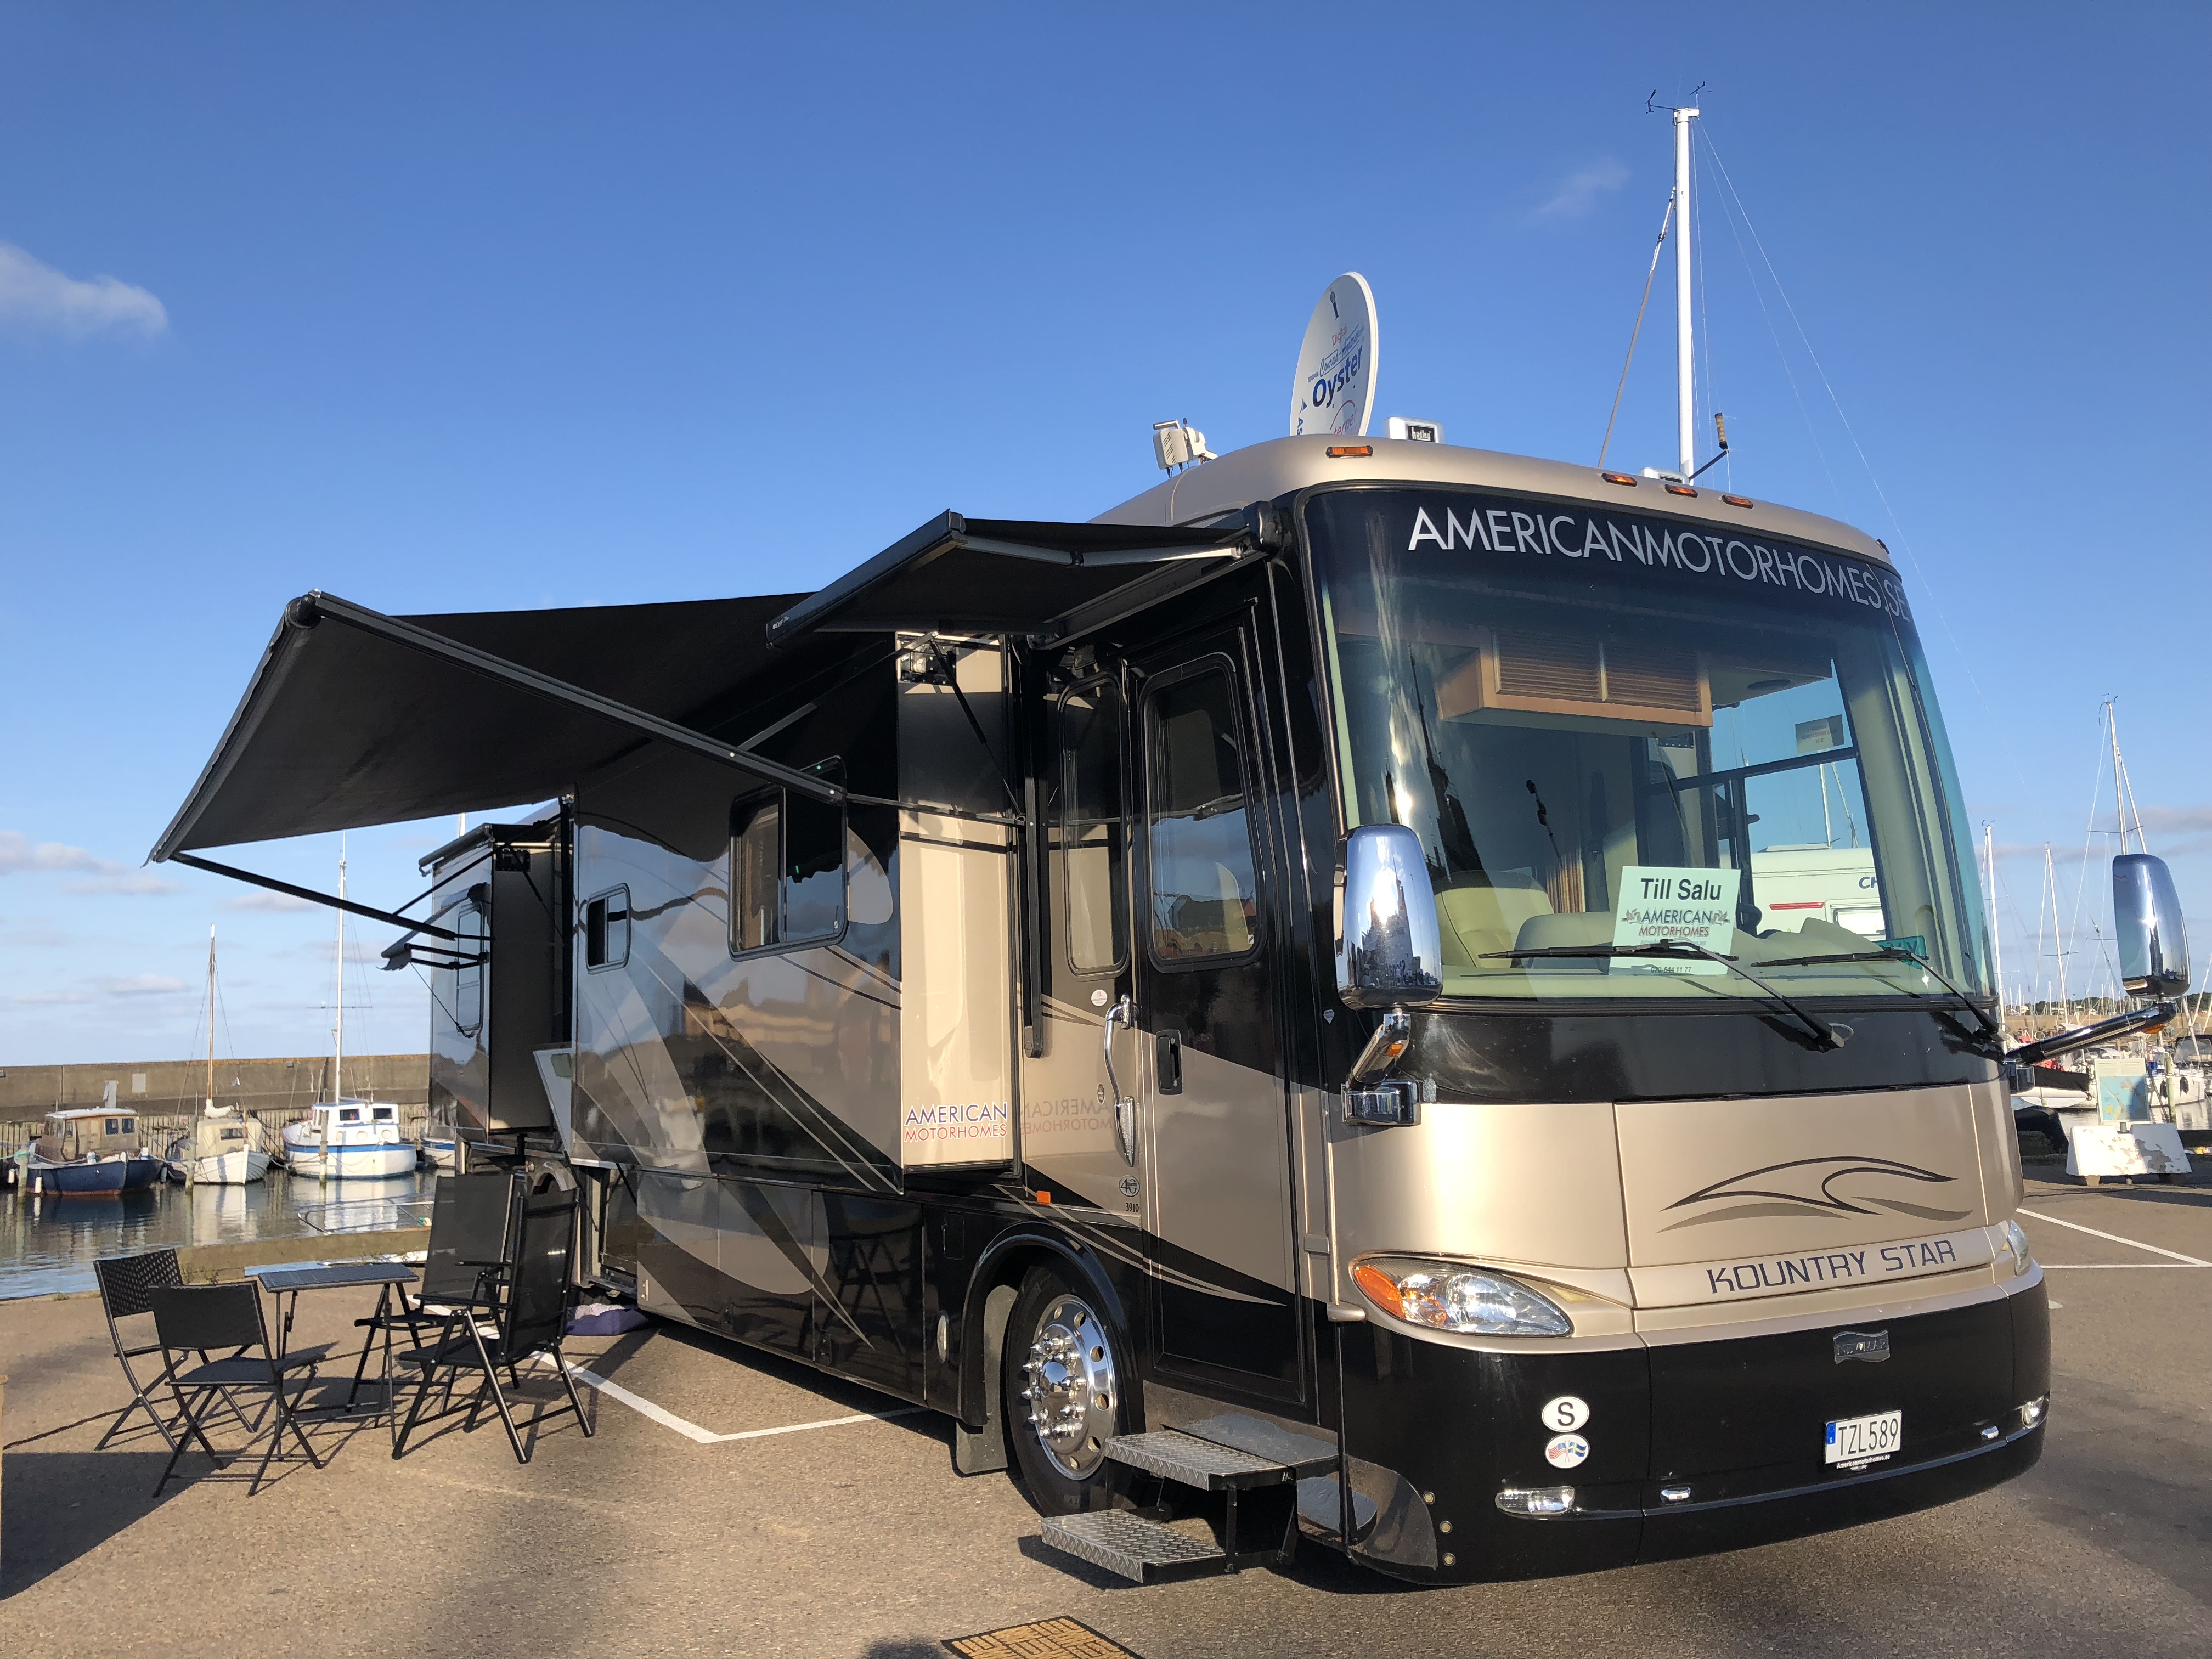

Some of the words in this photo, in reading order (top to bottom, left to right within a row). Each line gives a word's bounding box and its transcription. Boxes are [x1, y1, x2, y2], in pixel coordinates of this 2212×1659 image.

[1312, 345, 1363, 408] Oyster
[1412, 426, 1431, 442] hadley
[1640, 878, 1671, 900] Till
[1677, 878, 1722, 900] Salu
[1640, 909, 1713, 924] AMERICAN
[1638, 926, 1711, 937] MOTORHOMES
[904, 1102, 1008, 1126] AMERICAN
[904, 1123, 1007, 1143] MOTORHOMES
[1126, 1202, 1139, 1212] 3910
[1706, 1251, 1866, 1294] KOUNTRY
[1880, 1239, 1957, 1272] STAR
[1556, 1401, 1575, 1427] S
[1838, 1418, 1899, 1457] TZL589
[1836, 1454, 1891, 1469] Americanmotorhomes.se
